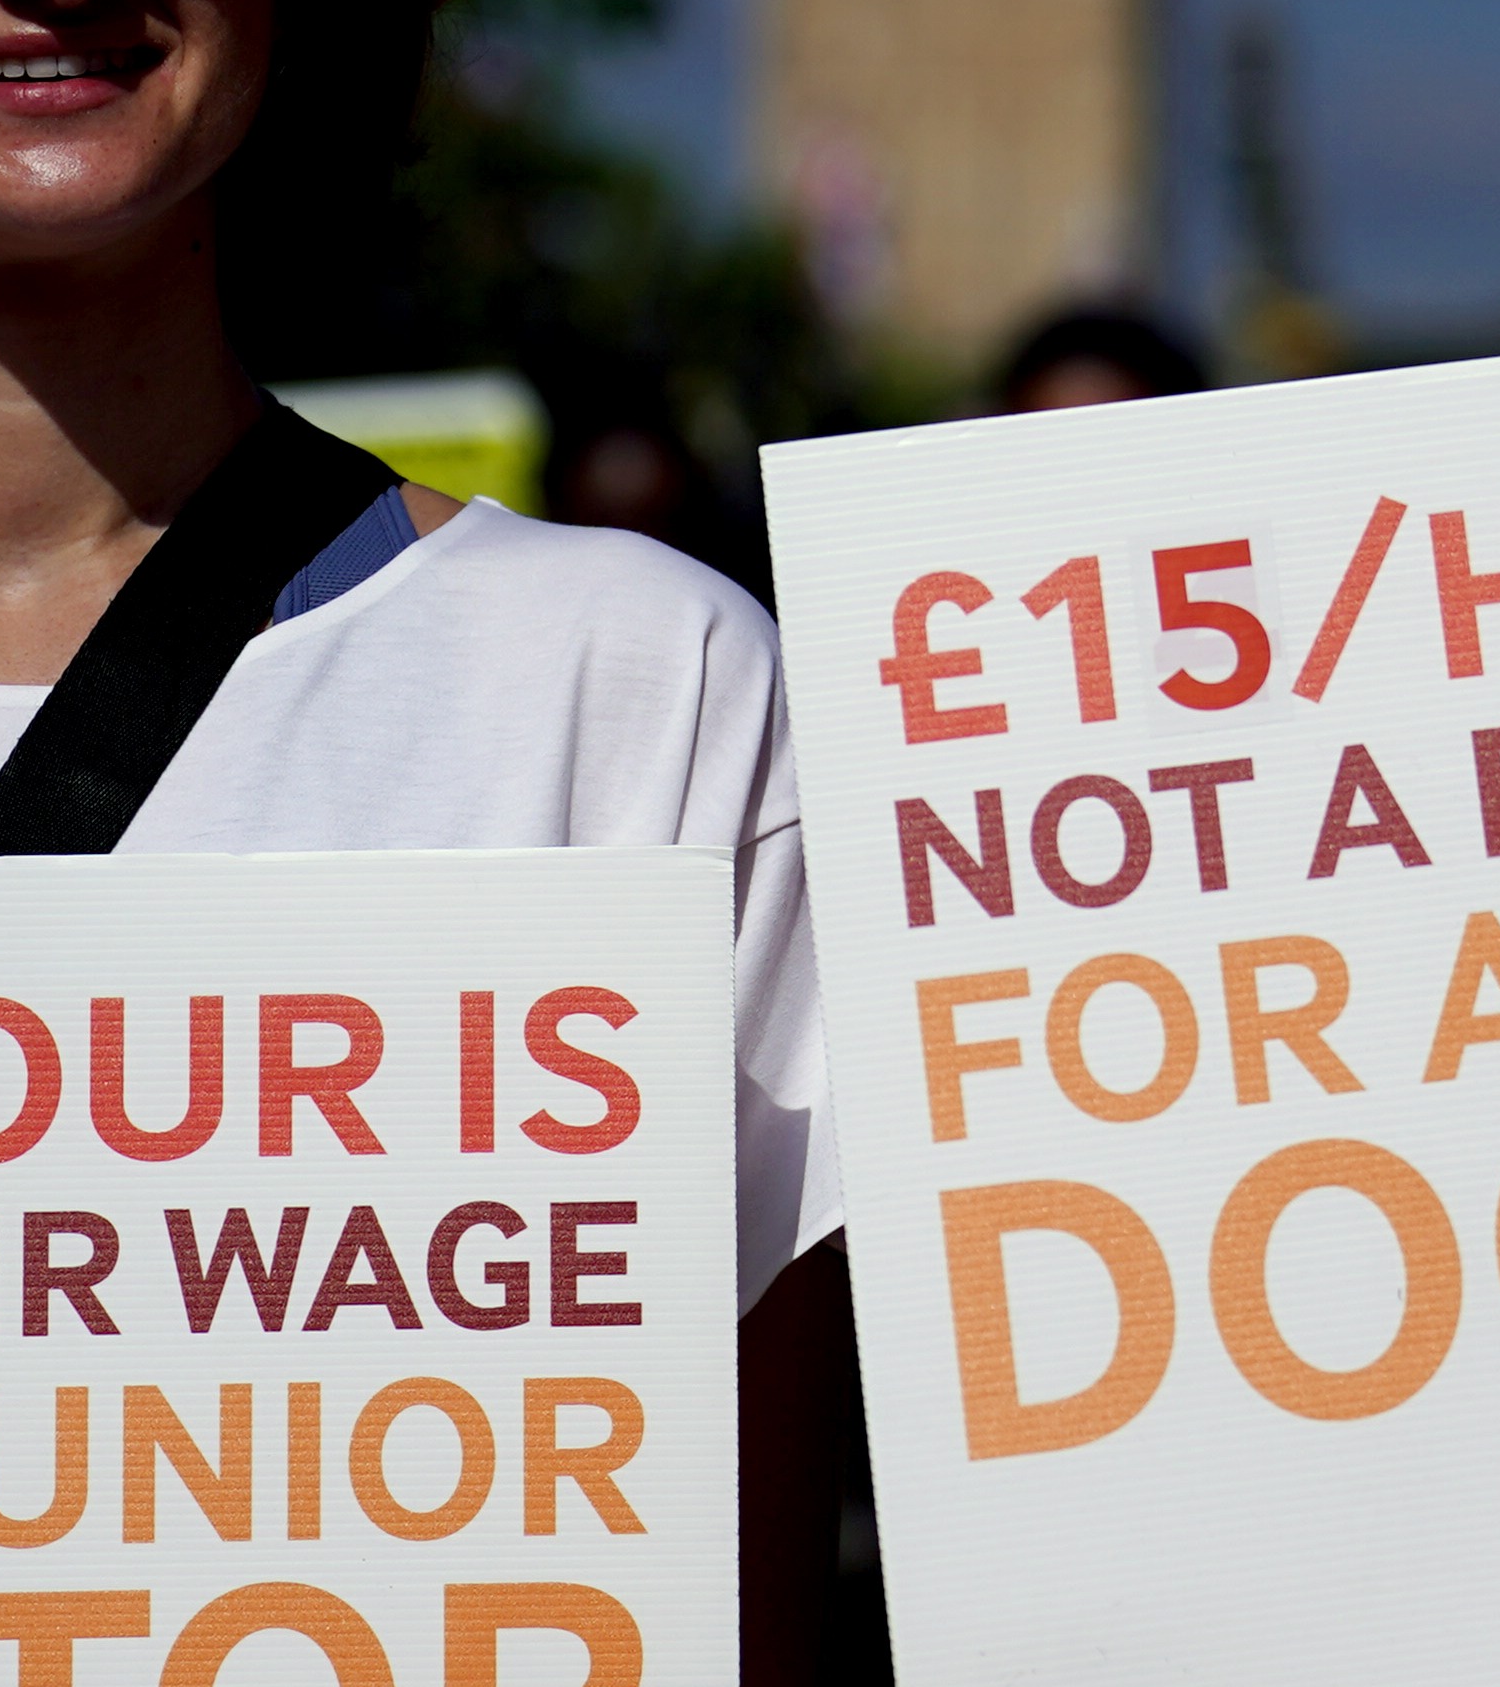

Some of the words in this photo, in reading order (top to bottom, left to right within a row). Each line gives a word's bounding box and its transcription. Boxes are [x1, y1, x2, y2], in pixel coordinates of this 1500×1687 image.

[896, 759, 1254, 927] NOT
[1309, 745, 1431, 878] A
[460, 986, 641, 1154] IS
[917, 936, 1364, 1141] FOR
[164, 1201, 642, 1333] WAGE
